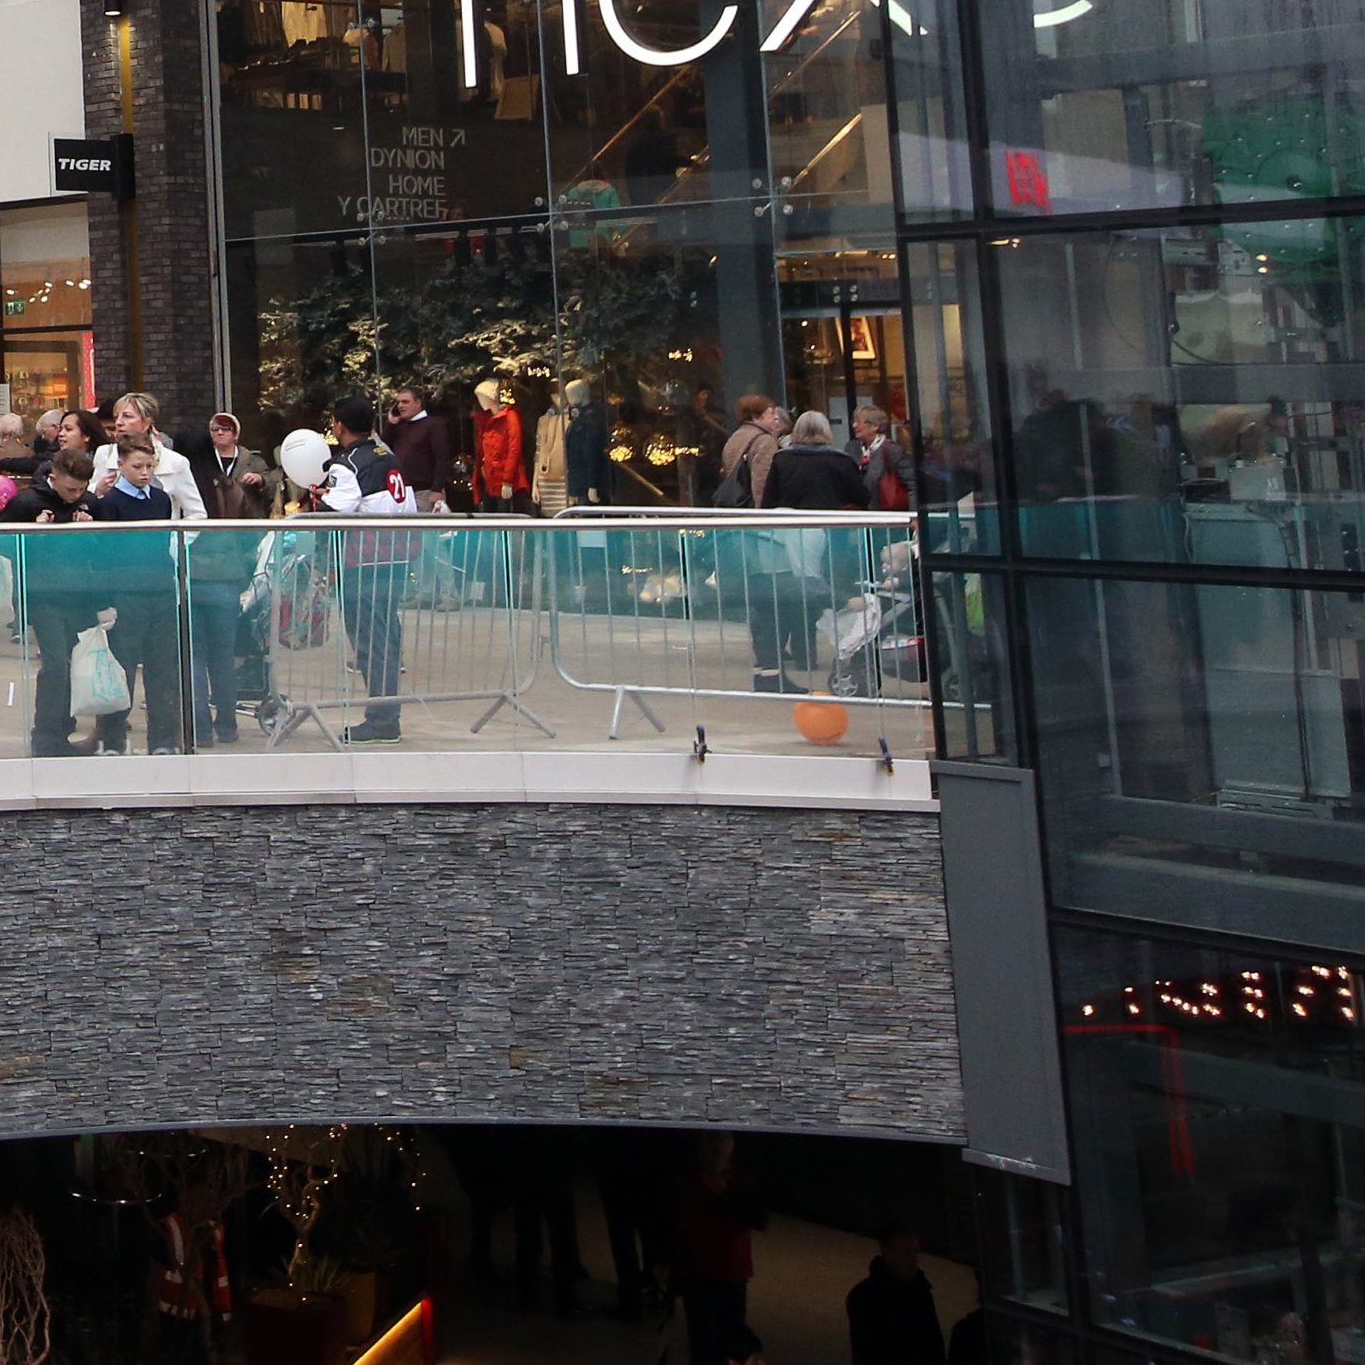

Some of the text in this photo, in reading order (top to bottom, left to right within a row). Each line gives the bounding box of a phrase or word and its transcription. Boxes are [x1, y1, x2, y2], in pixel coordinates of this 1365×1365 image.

[402, 125, 444, 147] MEN
[58, 158, 112, 172] TIGER
[370, 147, 445, 170] DYNION
[389, 174, 447, 196] HOME
[336, 195, 448, 220] Y CARTREF
[389, 472, 406, 499] 21
